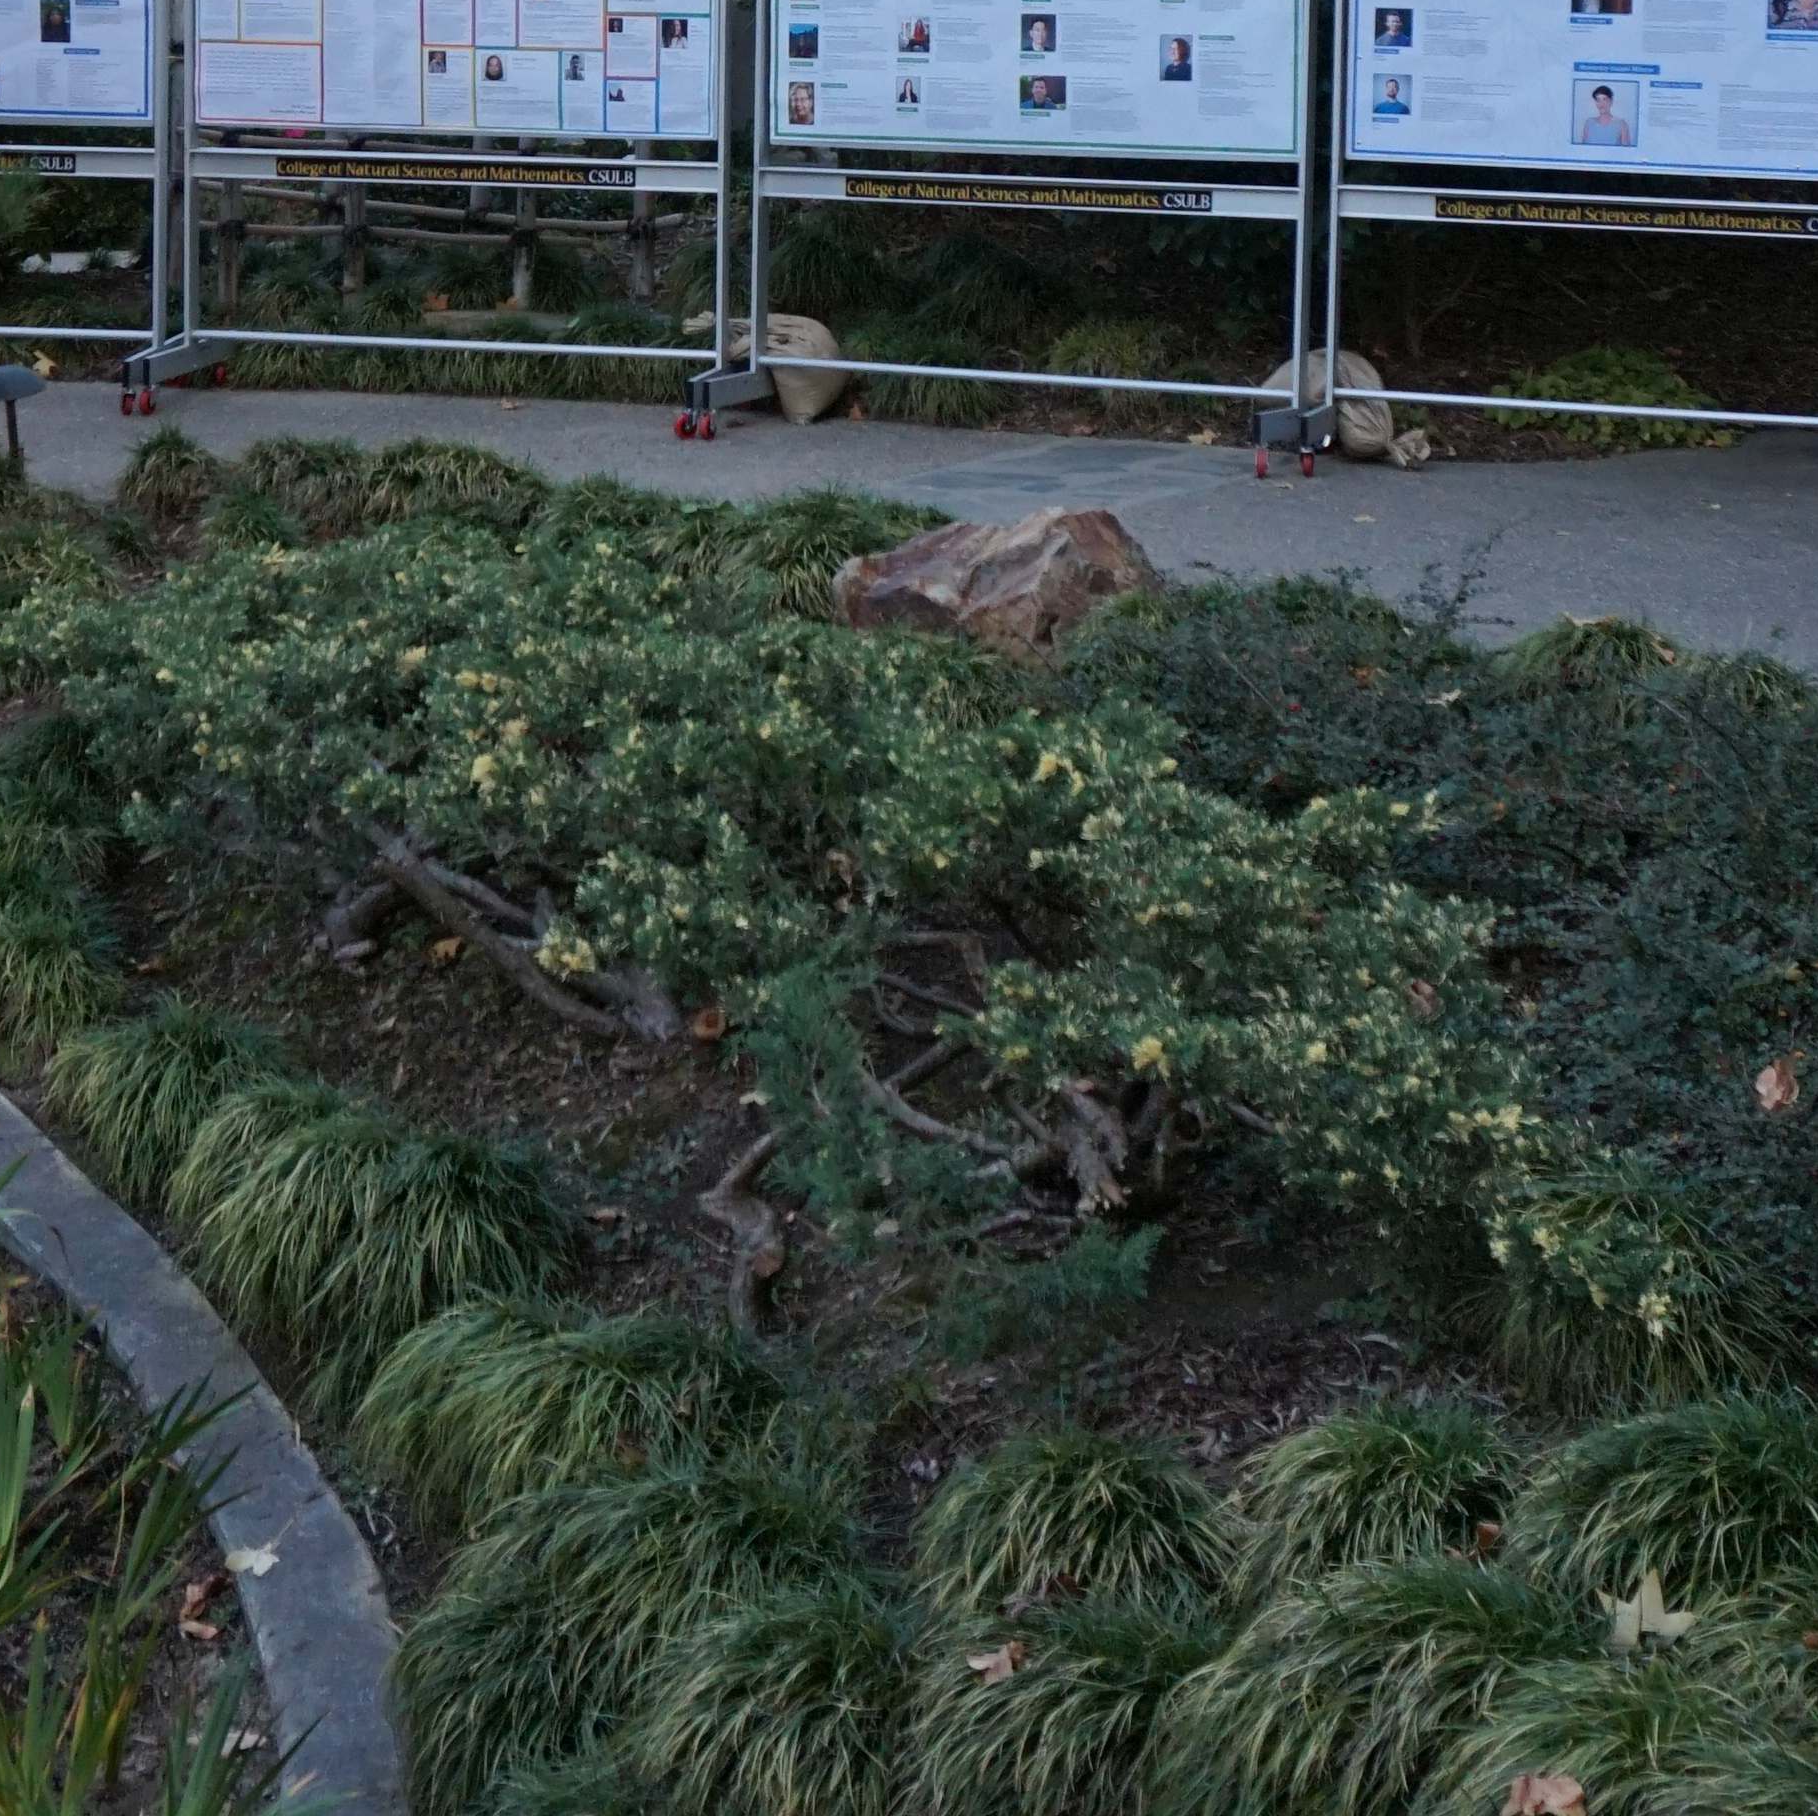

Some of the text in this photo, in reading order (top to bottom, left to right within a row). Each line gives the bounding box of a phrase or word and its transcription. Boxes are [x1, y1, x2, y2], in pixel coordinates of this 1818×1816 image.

[277, 161, 326, 177] College
[328, 162, 343, 175] of
[346, 162, 400, 177] Natural
[402, 165, 458, 179] Sciences
[460, 167, 487, 180] and
[588, 169, 634, 184] CSULB
[846, 180, 896, 198] College
[897, 182, 912, 197] of
[915, 183, 970, 200] Natural
[972, 186, 1029, 202] Sciences
[1031, 189, 1059, 204] and
[1163, 192, 1211, 209] CSULB
[1436, 200, 1495, 218] College
[1497, 203, 1514, 218] of
[1517, 204, 1581, 221] Natural
[1585, 207, 1651, 224] Sciences
[1653, 211, 1685, 226] and
